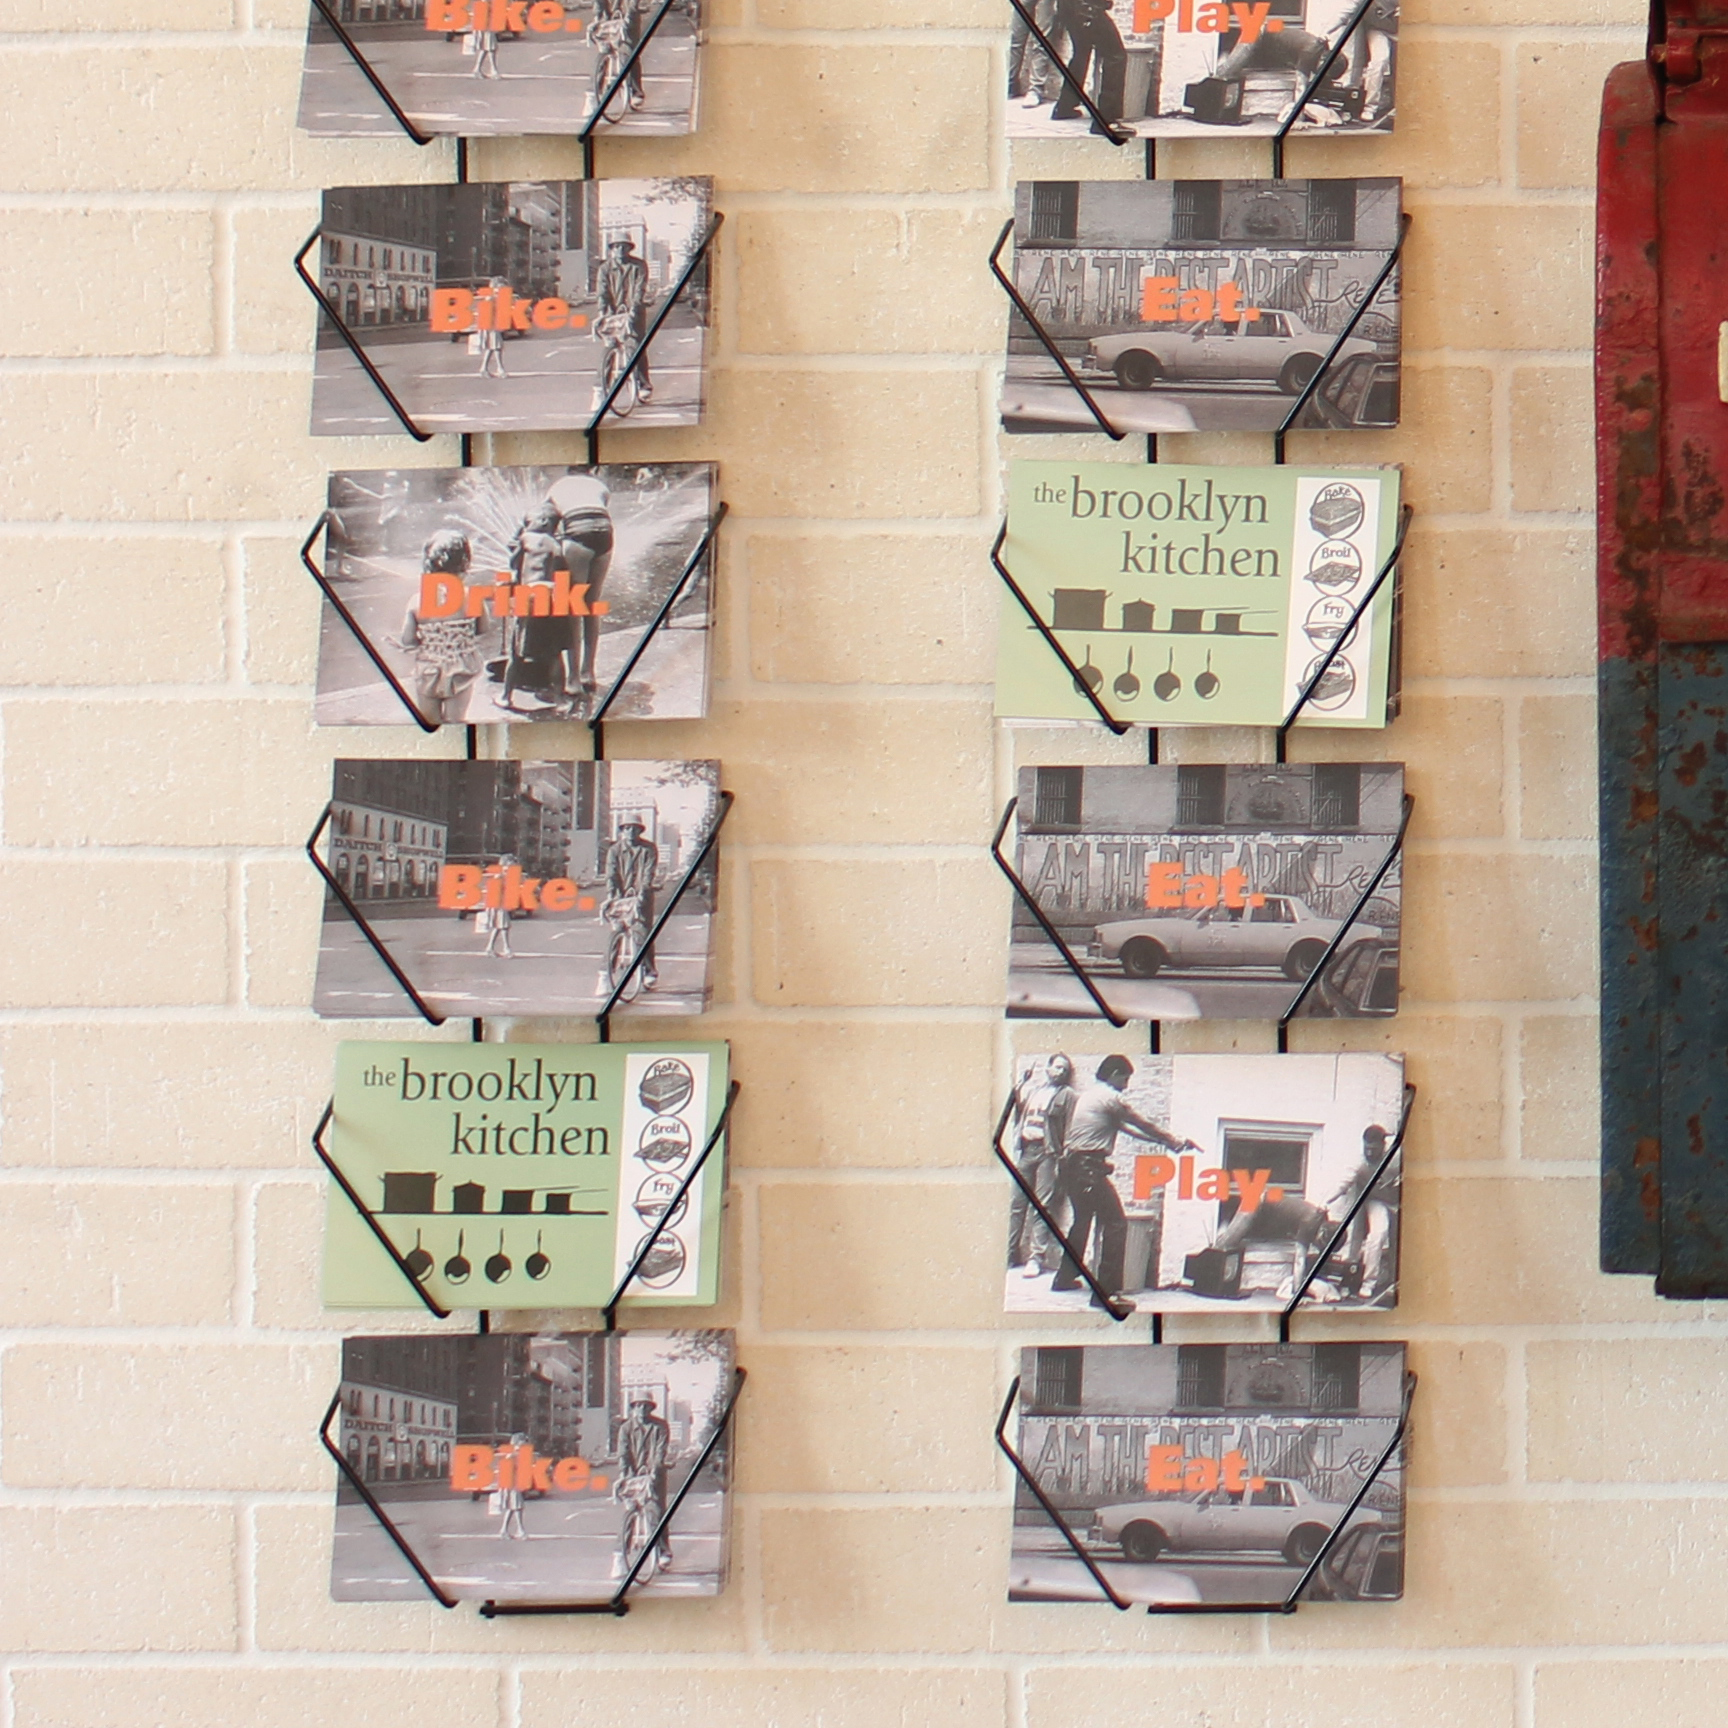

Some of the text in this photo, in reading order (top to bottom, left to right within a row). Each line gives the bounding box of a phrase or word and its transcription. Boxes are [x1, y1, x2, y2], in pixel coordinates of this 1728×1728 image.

[430, 286, 588, 333] Bike.
[1141, 276, 1260, 322] Eat.
[1033, 475, 1269, 534] the brooklyn
[1119, 531, 1281, 578] kitchen
[1321, 546, 1351, 558] Broil
[419, 570, 609, 618] Drink.
[1323, 601, 1345, 618] Fry
[438, 864, 595, 910] Bike.
[1146, 862, 1266, 908] Eat.
[362, 1054, 599, 1116] the brooklyn
[448, 1110, 611, 1158] kitchen
[650, 1122, 680, 1135] Broil
[652, 1177, 675, 1195] Fry
[1135, 1155, 1284, 1212] Play.
[451, 1444, 608, 1491] Bike.
[1146, 1446, 1265, 1492] Eat.
